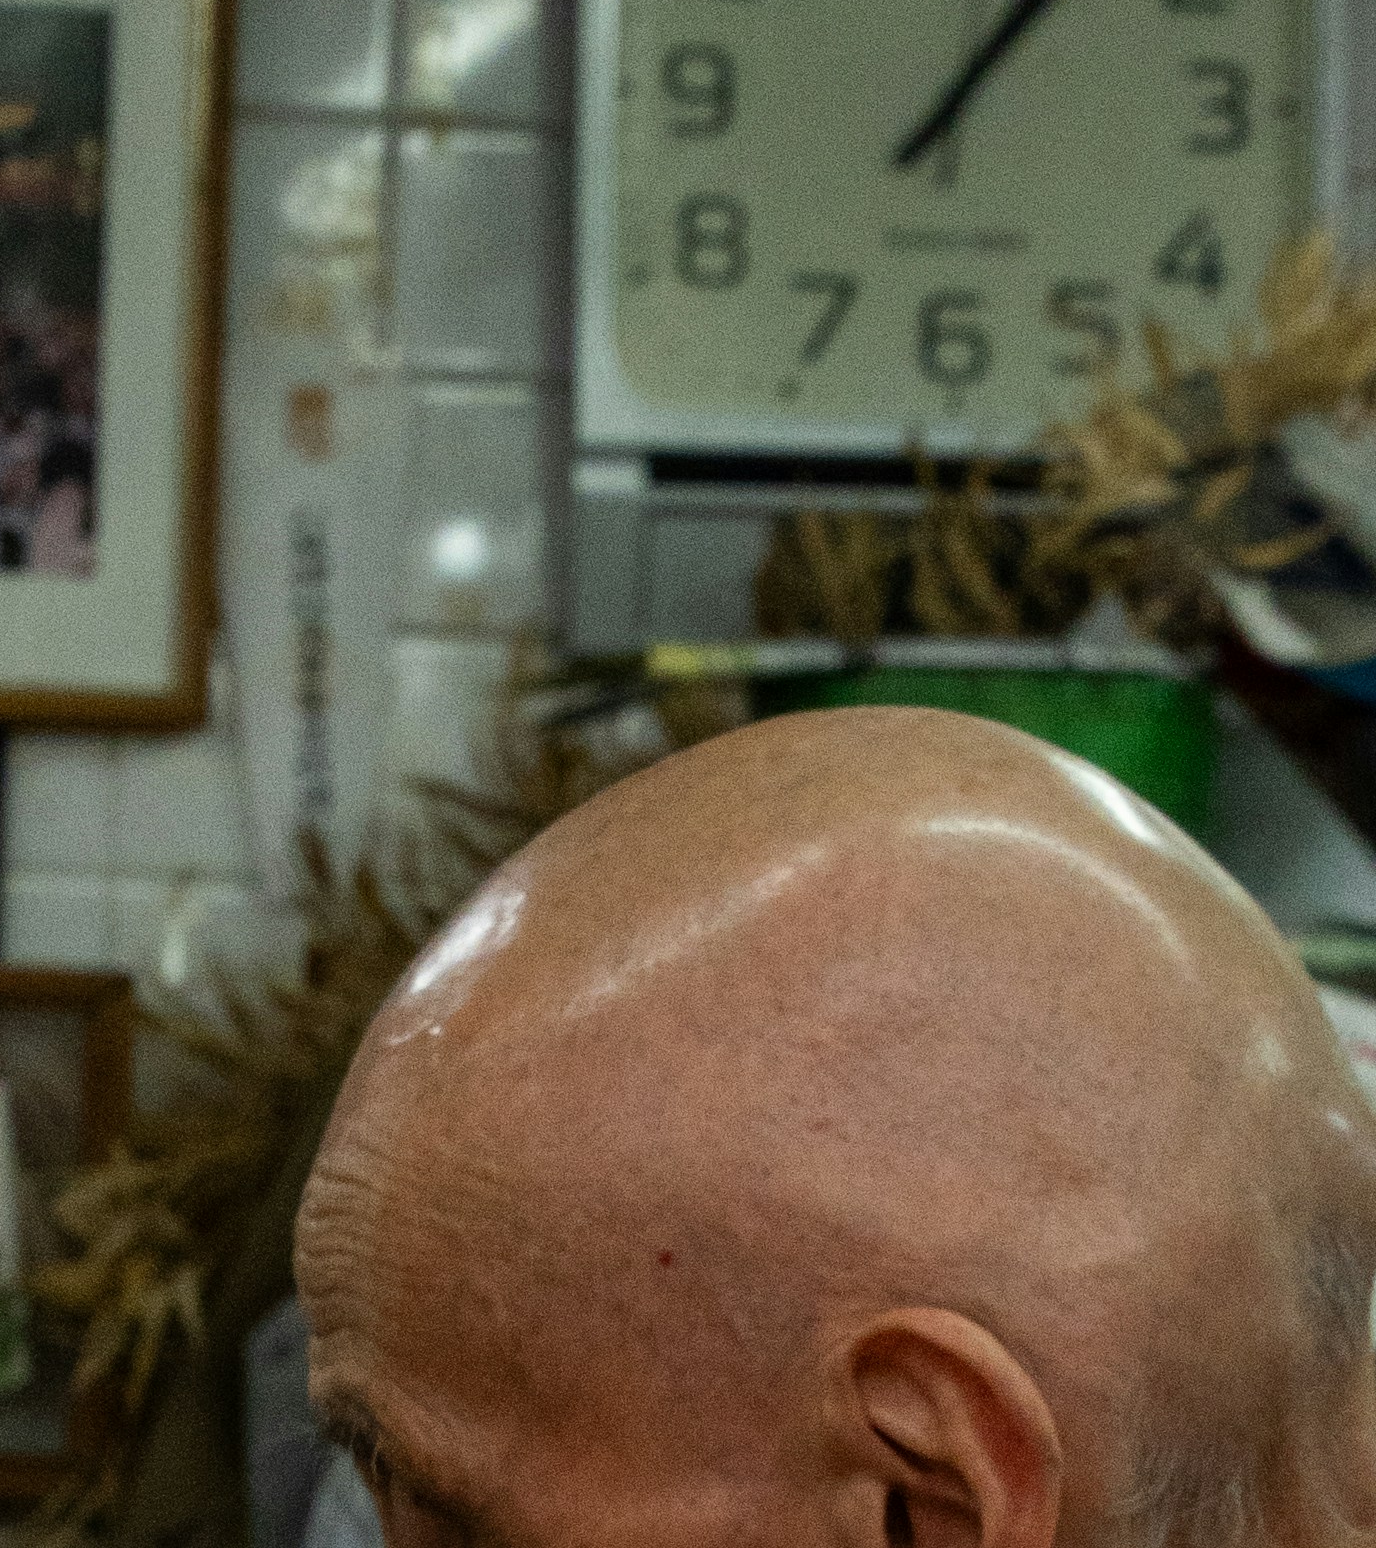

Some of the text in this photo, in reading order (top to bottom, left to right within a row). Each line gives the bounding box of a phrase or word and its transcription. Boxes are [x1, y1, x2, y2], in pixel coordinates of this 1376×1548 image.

[661, 43, 736, 139] 9
[1188, 57, 1252, 155] 3
[674, 193, 750, 290] 8
[1152, 208, 1226, 298] 4
[789, 269, 859, 367] 7
[916, 289, 993, 387] 6
[1046, 276, 1122, 376] 5
